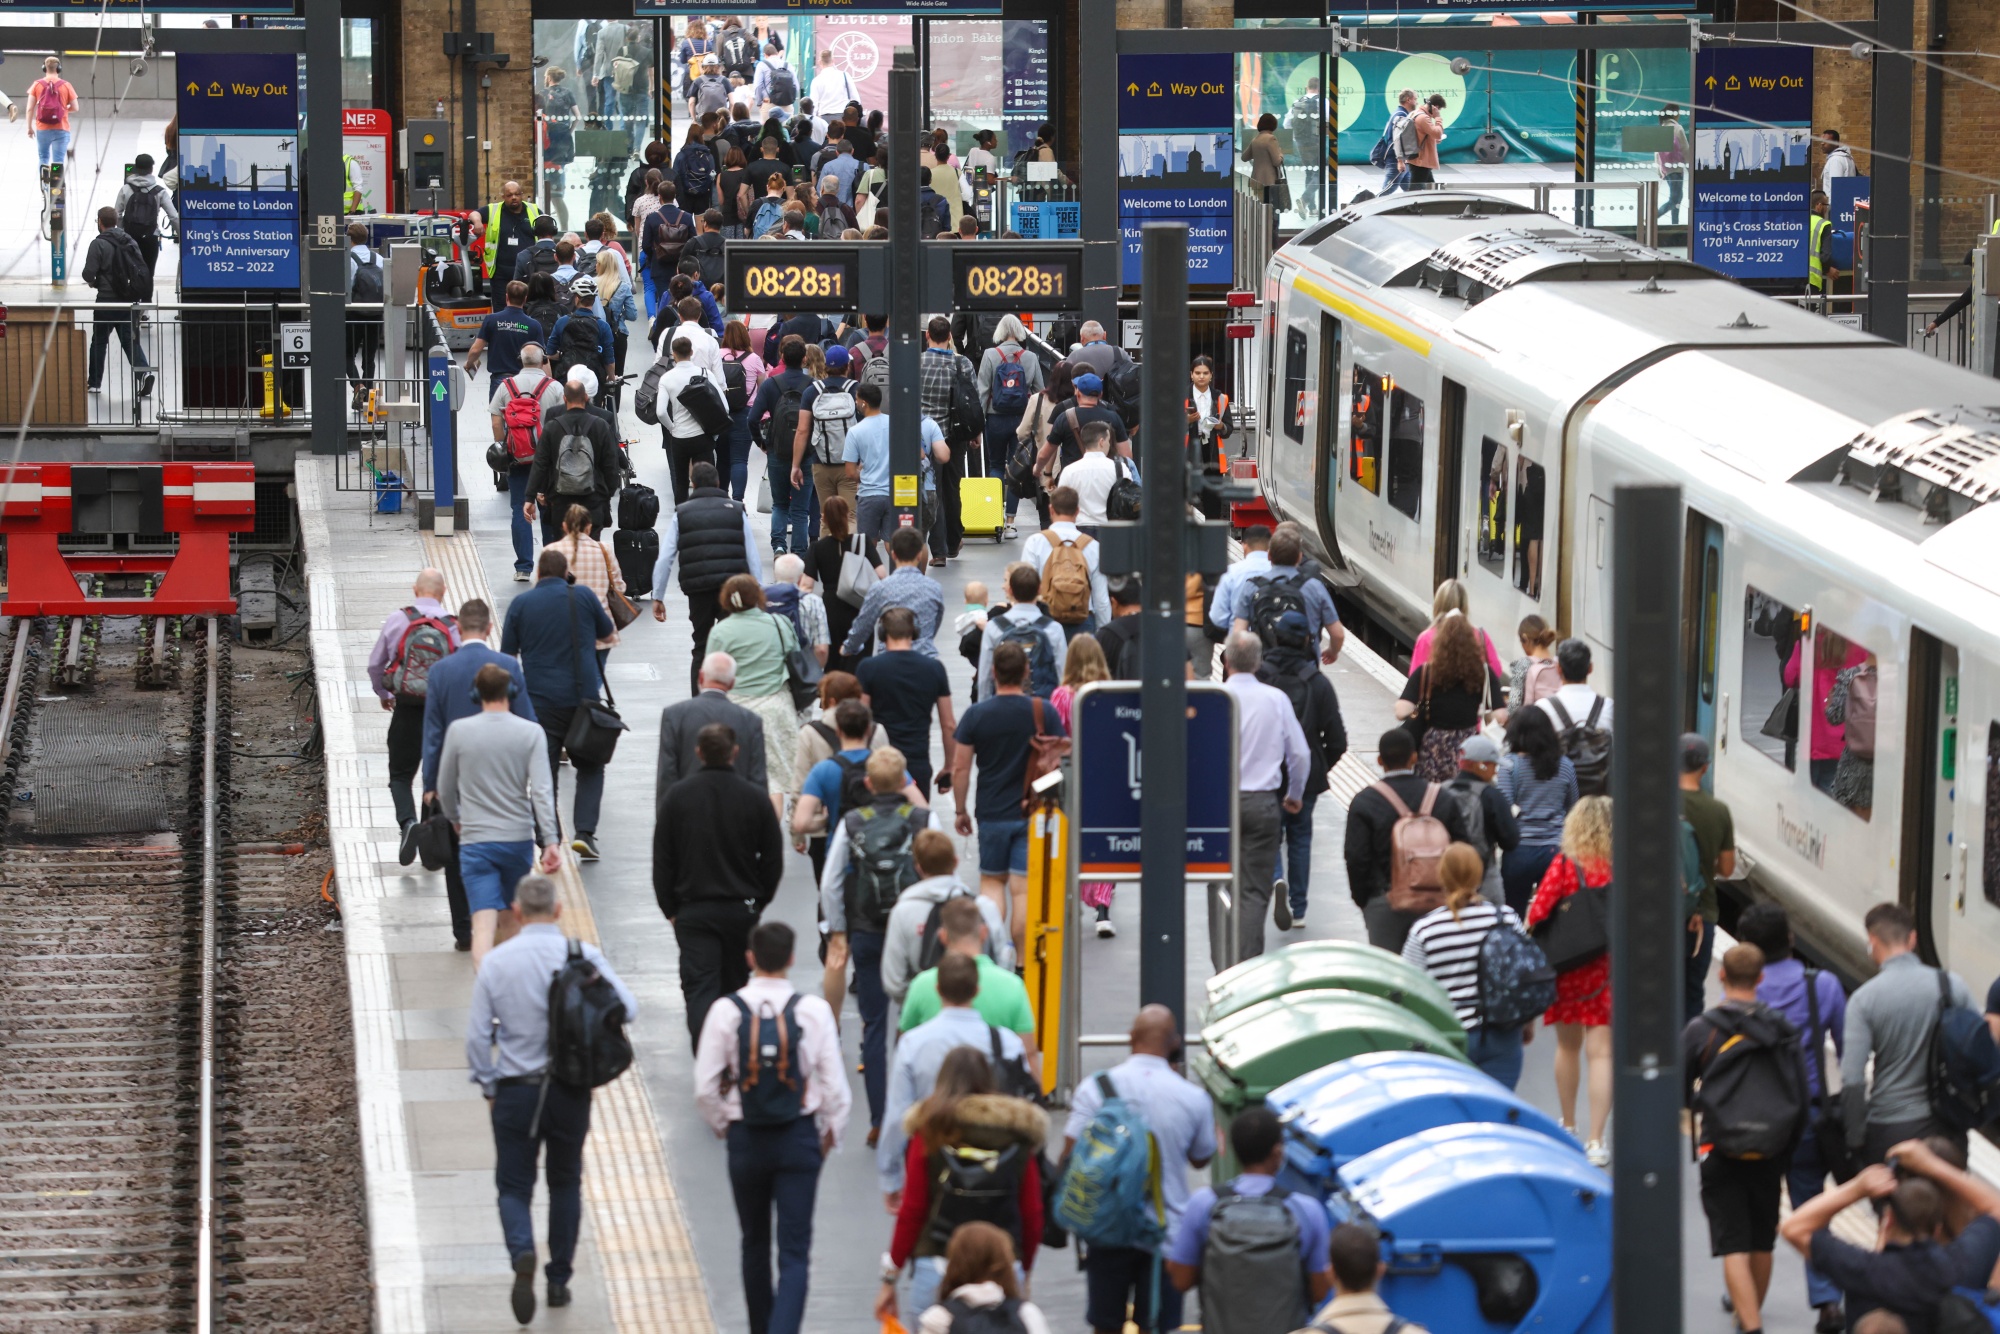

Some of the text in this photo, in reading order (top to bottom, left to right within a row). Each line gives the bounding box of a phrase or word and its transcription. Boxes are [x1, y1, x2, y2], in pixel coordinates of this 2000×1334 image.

[827, 15, 888, 25] Little
[929, 34, 964, 43] ondon
[1749, 76, 1804, 90] Way Out
[231, 83, 260, 97] Way
[263, 83, 288, 96] Out
[1170, 82, 1225, 96] Way Out
[931, 108, 995, 116] Friday until
[342, 112, 376, 127] NER
[1699, 192, 1804, 203] Welcome to London
[185, 200, 293, 211] Welcome to London
[1123, 198, 1227, 209] Welcome to London
[324, 217, 329, 225] E
[1056, 212, 1078, 223] FREE
[1840, 211, 1856, 222] thi
[1019, 217, 1040, 229] FREE
[1699, 221, 1803, 234] King's Cross Station
[186, 230, 293, 242] King's Cross Station
[1188, 228, 1227, 238] Station
[321, 236, 333, 244] 04
[1702, 235, 1799, 249] 170th Anniversary
[190, 244, 290, 258] 170th Anniversary
[1717, 253, 1744, 263] 1852
[1756, 252, 1783, 263] 2022
[207, 262, 234, 272] 1852
[247, 262, 275, 272] 2022
[1185, 258, 1208, 269] 022
[497, 320, 529, 330] brightline
[293, 335, 304, 350] 6
[289, 355, 296, 364] R
[432, 369, 446, 377] Exit
[1107, 835, 1141, 852] Troll
